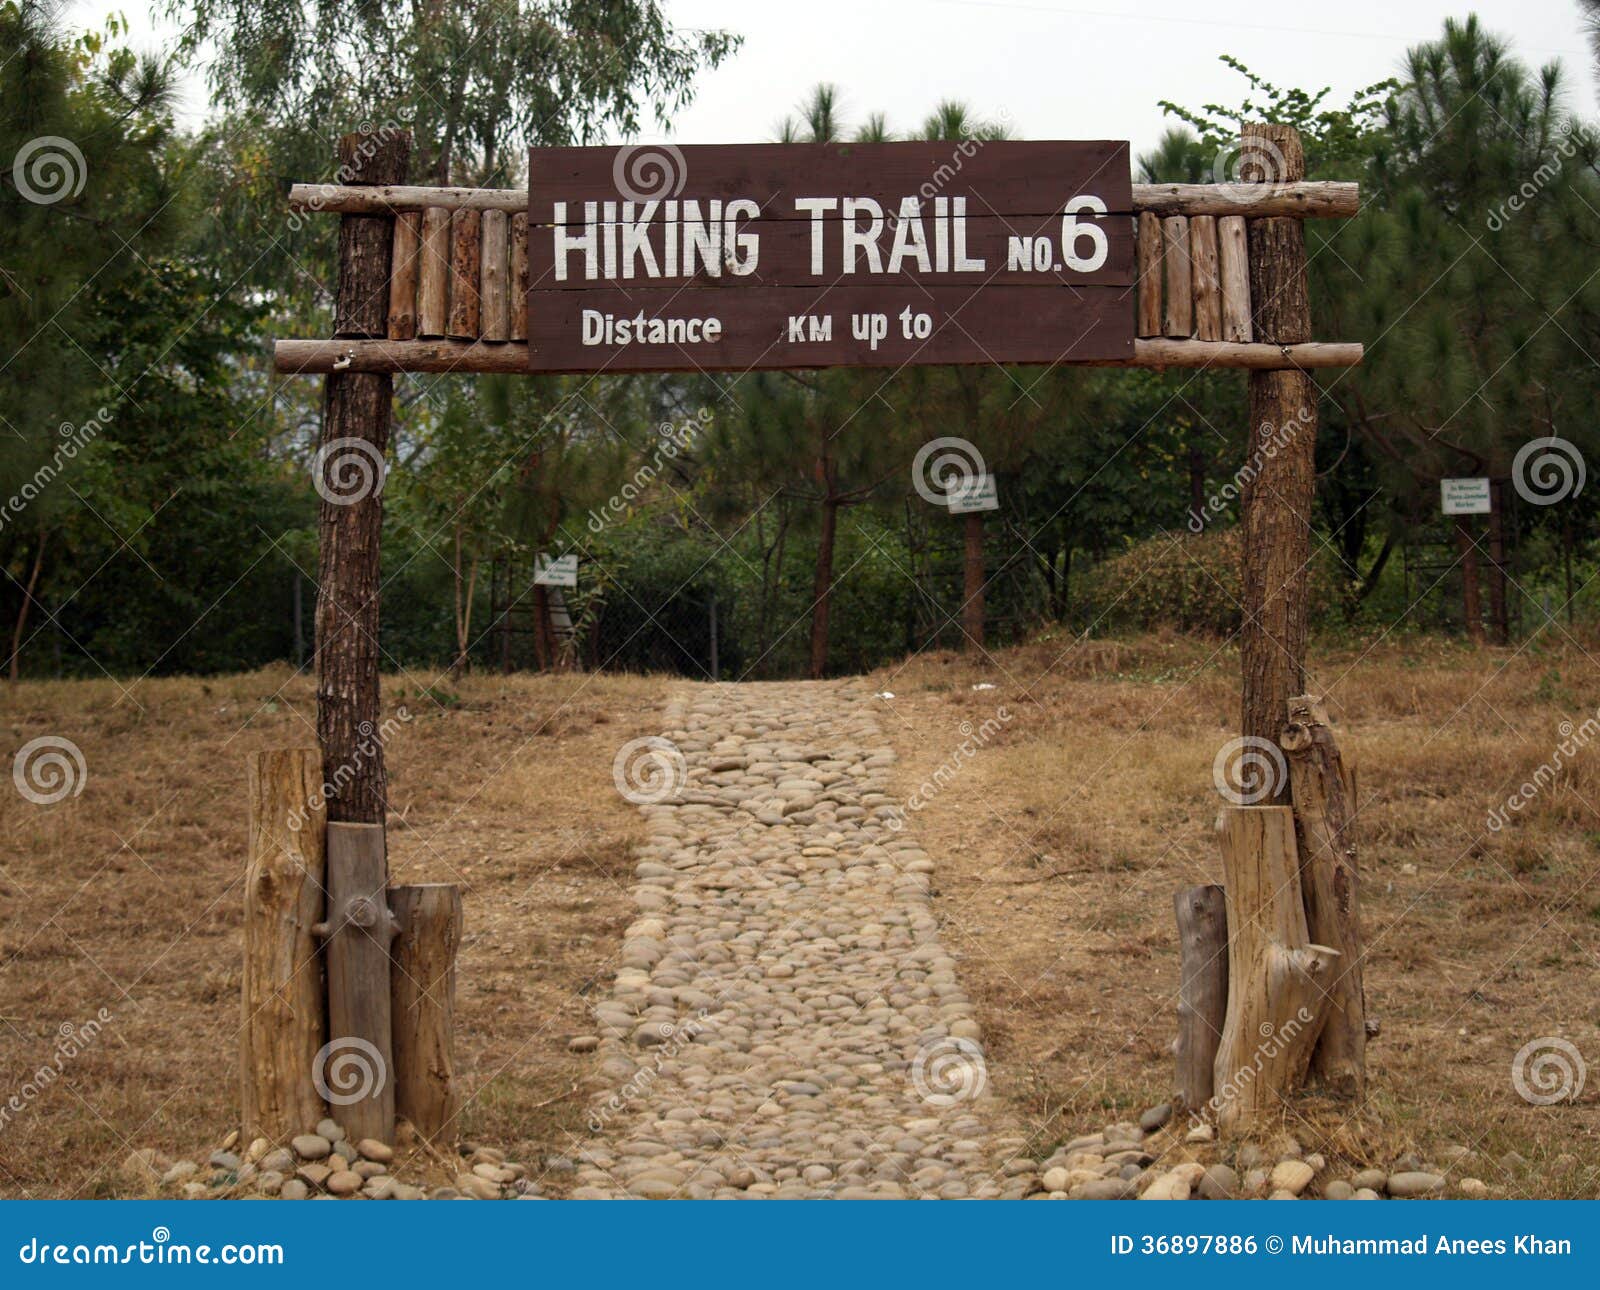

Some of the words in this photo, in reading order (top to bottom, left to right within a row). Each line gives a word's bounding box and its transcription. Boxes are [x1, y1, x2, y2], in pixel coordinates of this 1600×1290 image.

[554, 199, 761, 281] HIKING
[795, 196, 986, 275] TRAIL
[582, 309, 722, 346] Distance
[788, 315, 832, 342] KM
[852, 312, 887, 350] up
[899, 305, 933, 339] to
